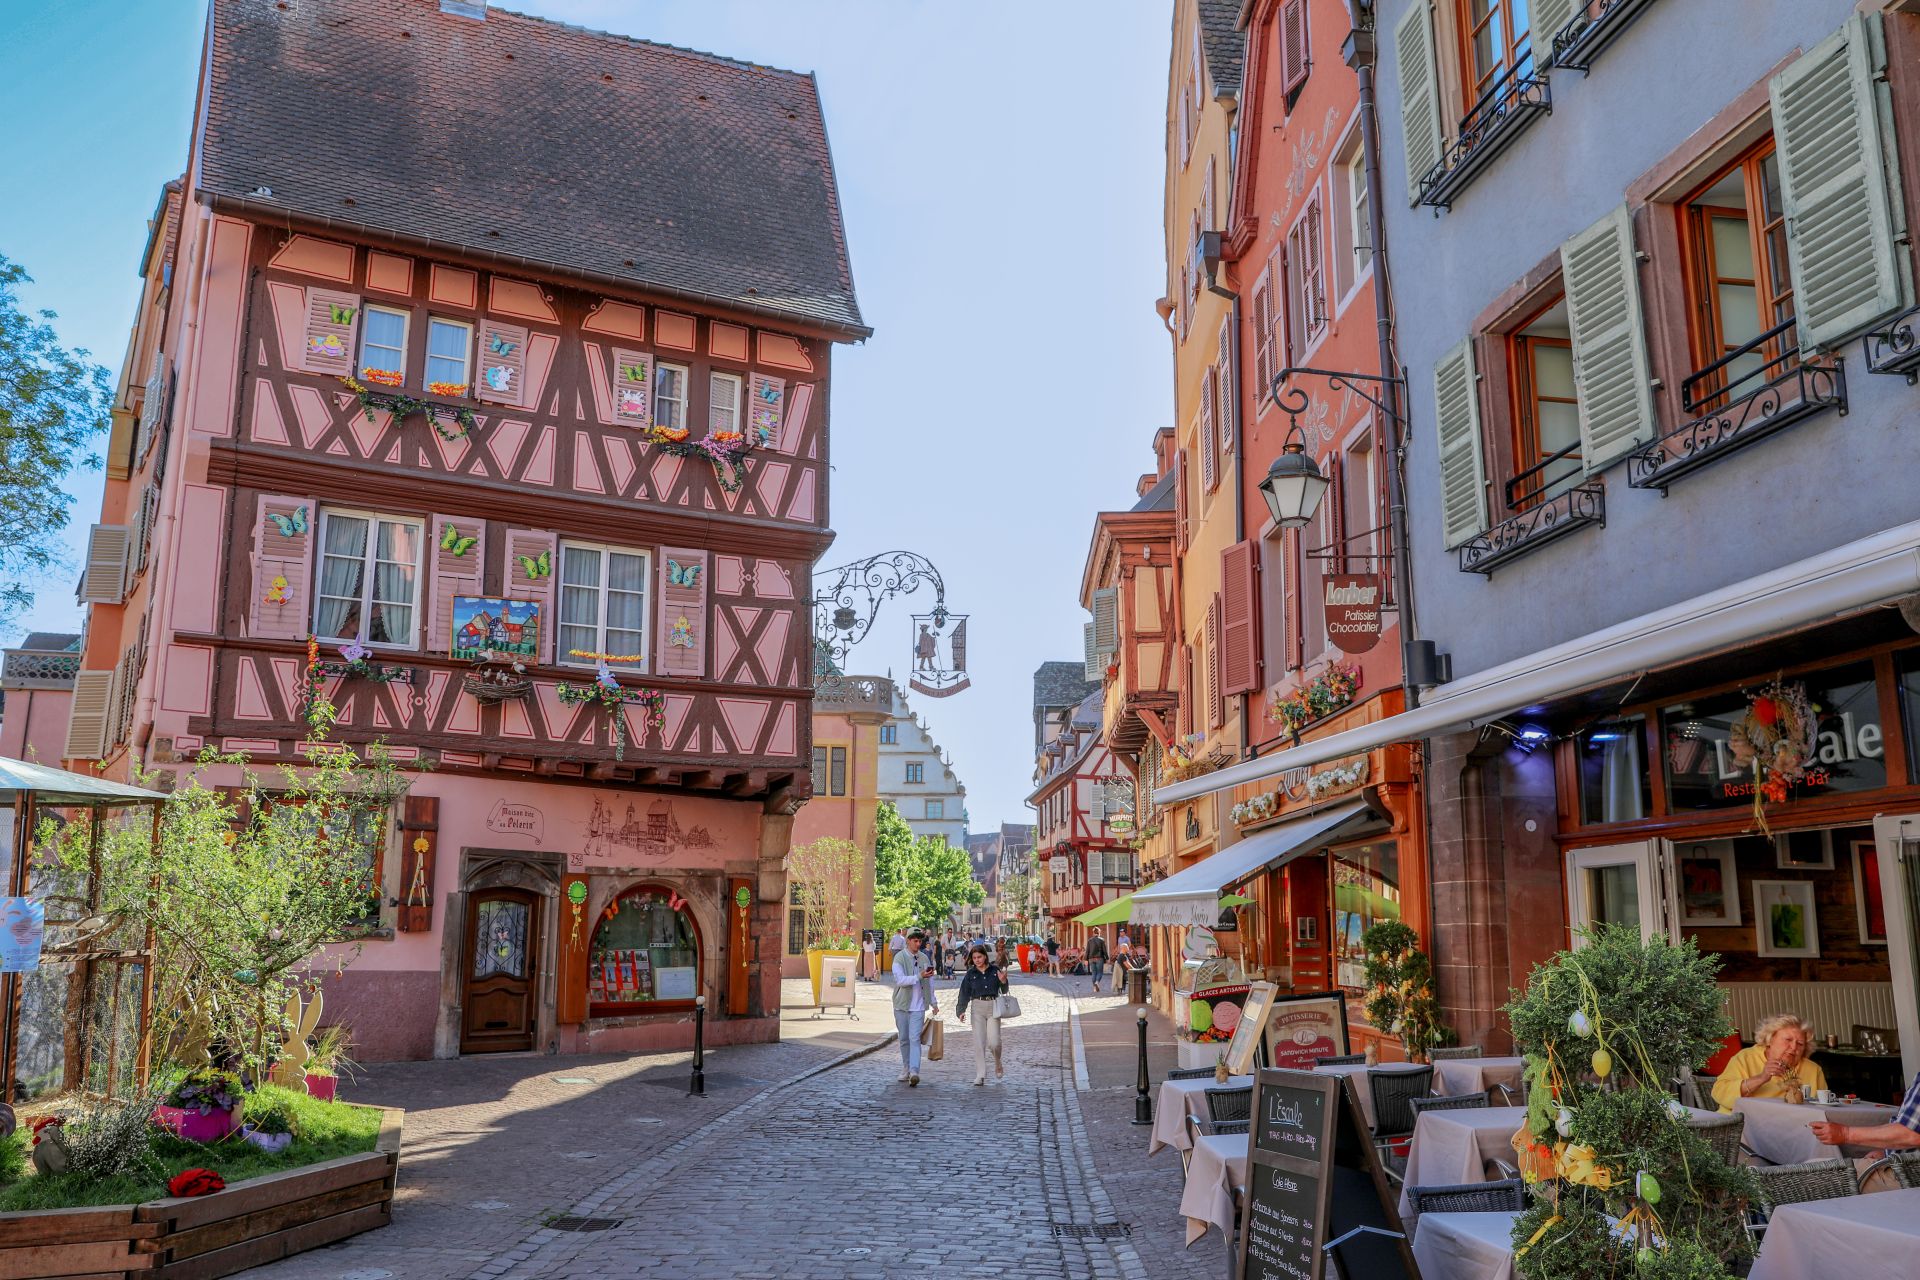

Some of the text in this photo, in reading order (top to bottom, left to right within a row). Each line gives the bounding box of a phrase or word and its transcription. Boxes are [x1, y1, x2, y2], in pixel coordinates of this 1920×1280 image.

[1325, 582, 1377, 605] Lorber
[1329, 622, 1379, 633] Chocolatier
[502, 808, 524, 817] Maison
[1198, 989, 1219, 997] GLACES
[1280, 1046, 1329, 1057] SANDWICH MINUTE
